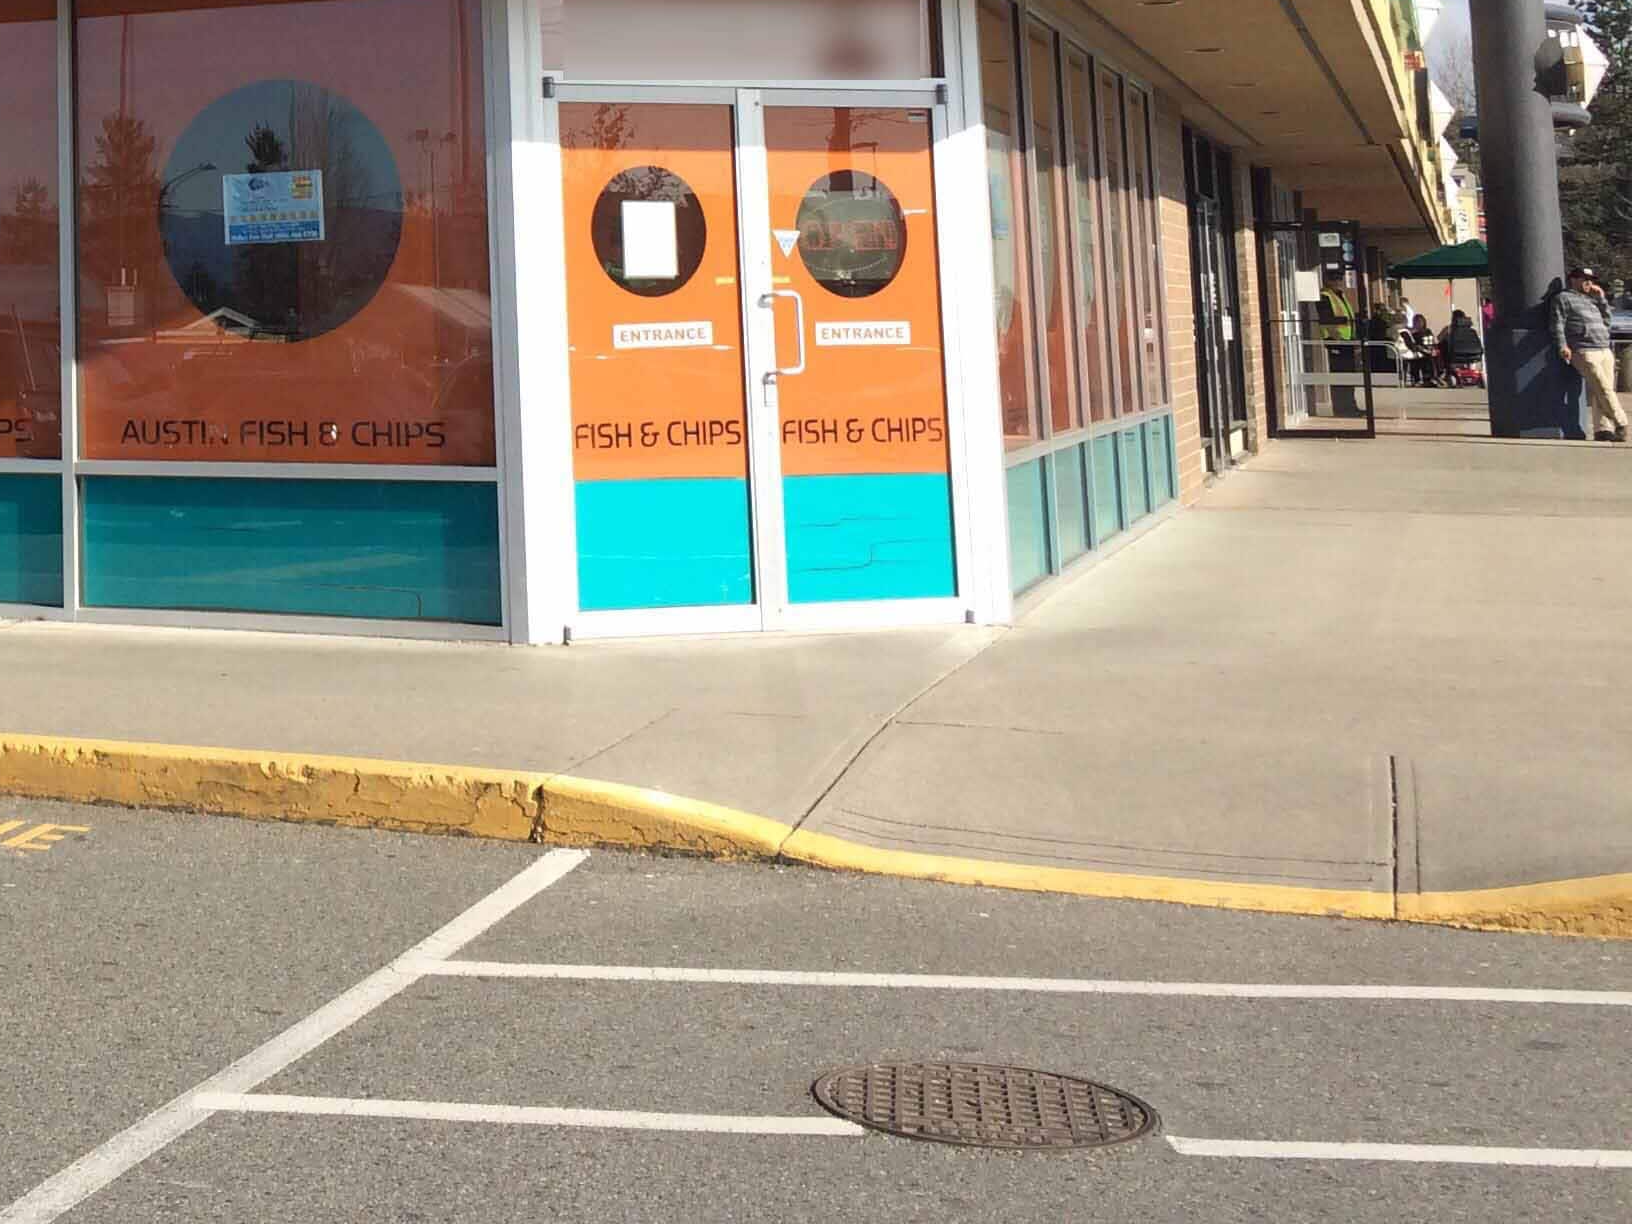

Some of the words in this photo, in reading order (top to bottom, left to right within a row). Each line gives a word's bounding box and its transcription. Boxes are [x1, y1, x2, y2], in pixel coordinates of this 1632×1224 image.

[619, 326, 708, 343] ENTRANCE
[820, 326, 905, 341] ENTRANCE
[239, 420, 309, 446] FISH
[319, 421, 342, 446] &
[351, 421, 446, 448] CHIPS
[574, 422, 633, 449] FISH
[640, 421, 661, 447] &
[667, 419, 742, 447] CHIPS
[782, 419, 839, 444] FISH
[846, 418, 865, 443] &
[871, 417, 943, 444] CHIPS
